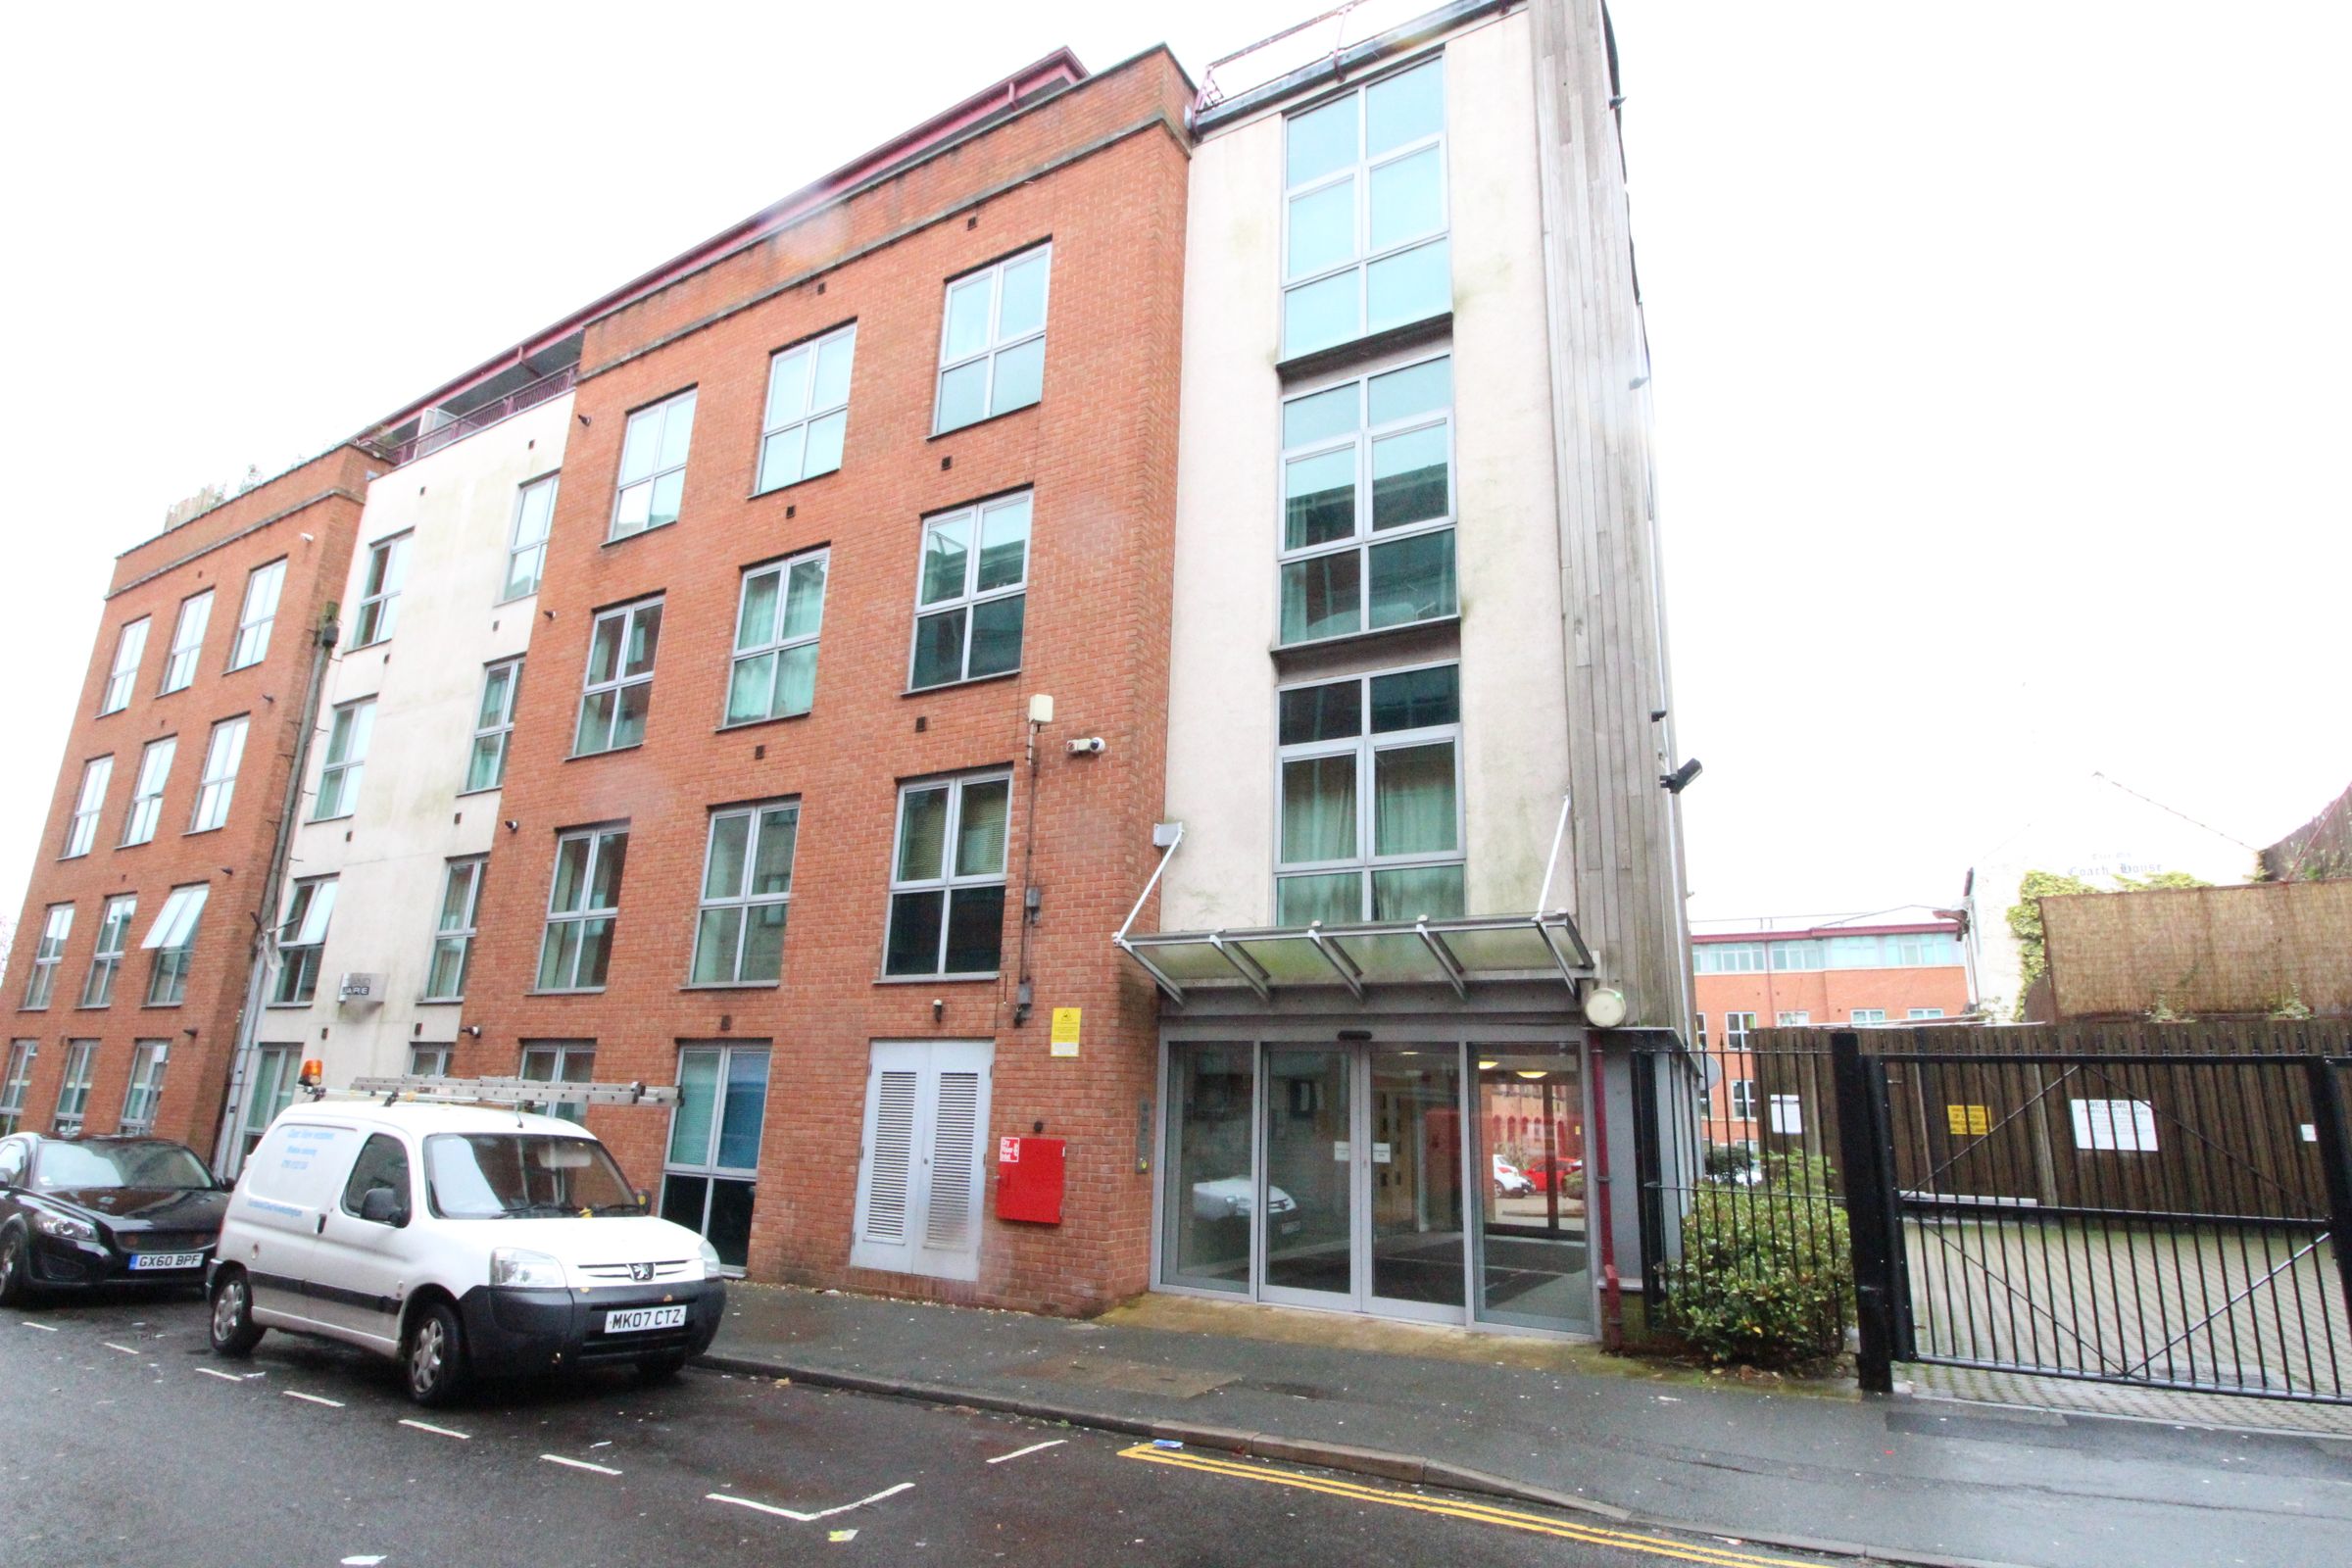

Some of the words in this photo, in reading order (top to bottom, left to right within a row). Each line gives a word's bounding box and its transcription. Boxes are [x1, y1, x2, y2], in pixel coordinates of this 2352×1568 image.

[139, 1255, 173, 1267] GX60
[175, 1254, 200, 1266] BPF
[612, 1311, 652, 1329] MK07
[655, 1308, 681, 1326] CTZ
